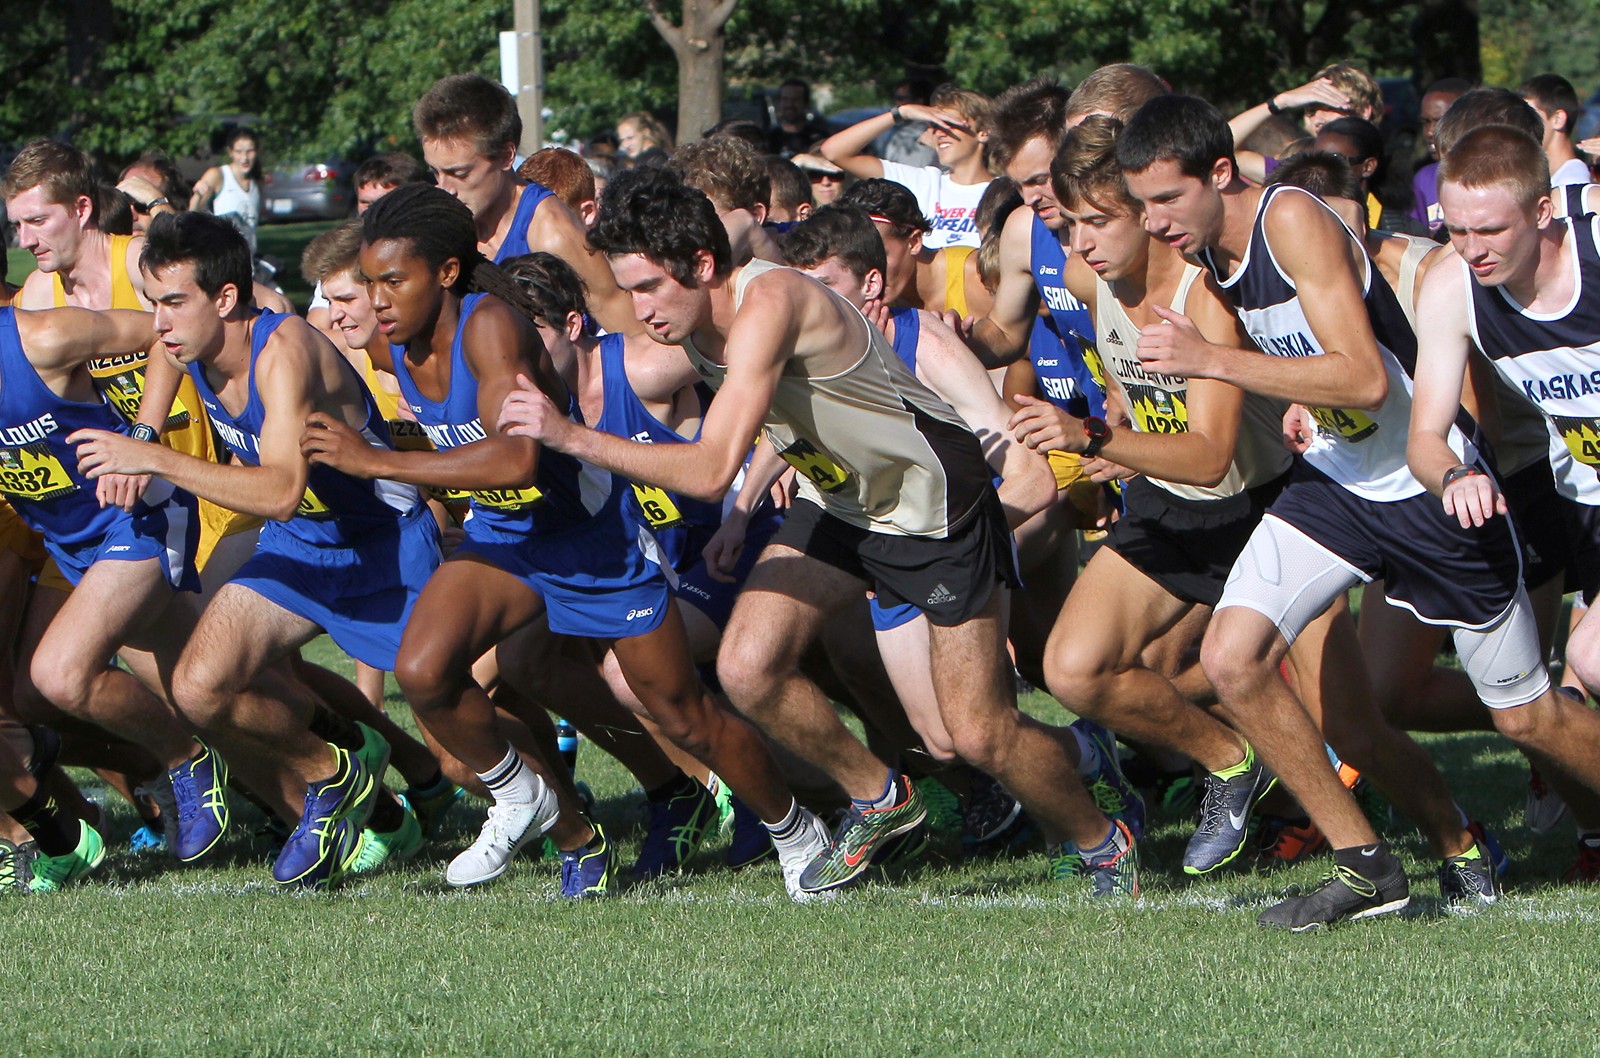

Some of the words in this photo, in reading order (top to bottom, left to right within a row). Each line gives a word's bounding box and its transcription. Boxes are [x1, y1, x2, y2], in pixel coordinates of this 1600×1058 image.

[935, 202, 967, 218] VER
[0, 413, 59, 446] LOUIS
[1582, 440, 1600, 460] 4
[686, 583, 711, 601] asics
